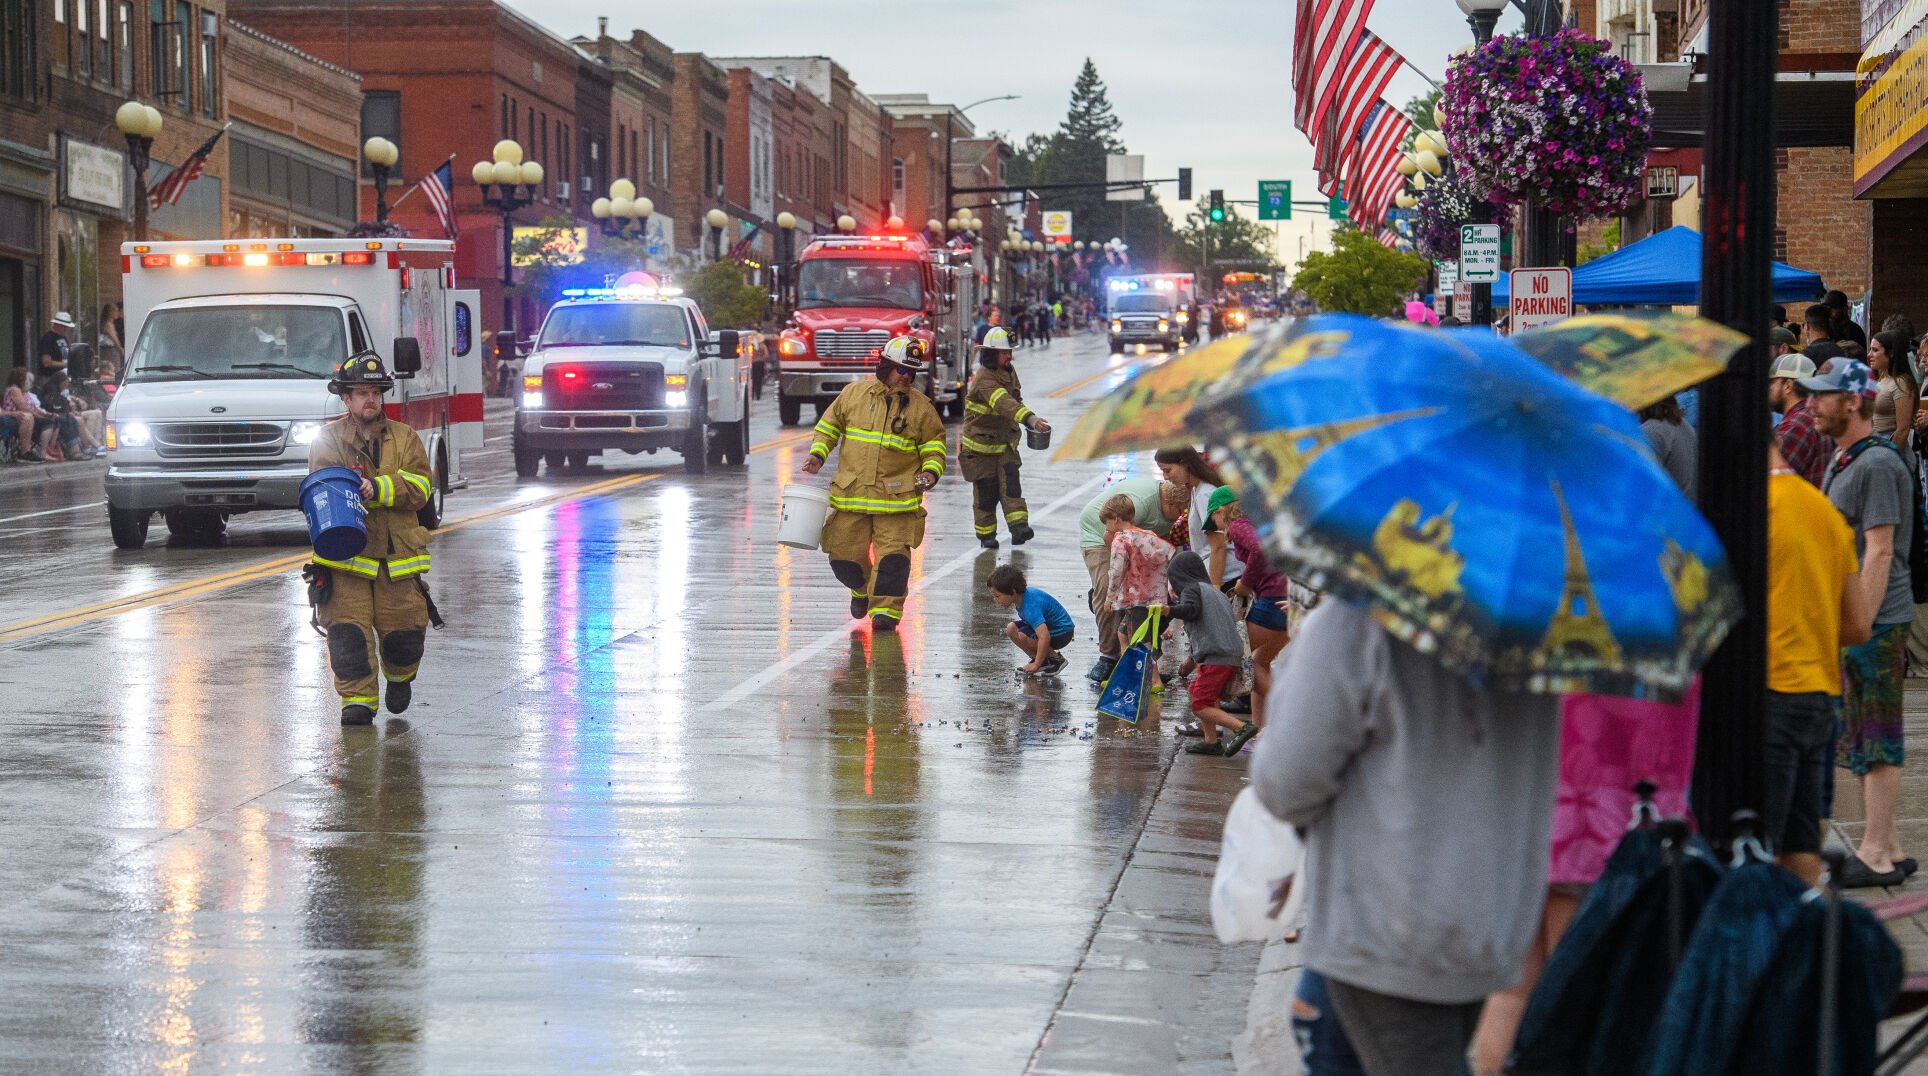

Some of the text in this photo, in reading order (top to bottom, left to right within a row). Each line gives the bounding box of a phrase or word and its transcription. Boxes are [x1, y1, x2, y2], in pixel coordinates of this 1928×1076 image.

[1464, 229, 1473, 242] 2
[1533, 276, 1548, 294] NO
[1515, 297, 1566, 315] PARKING
